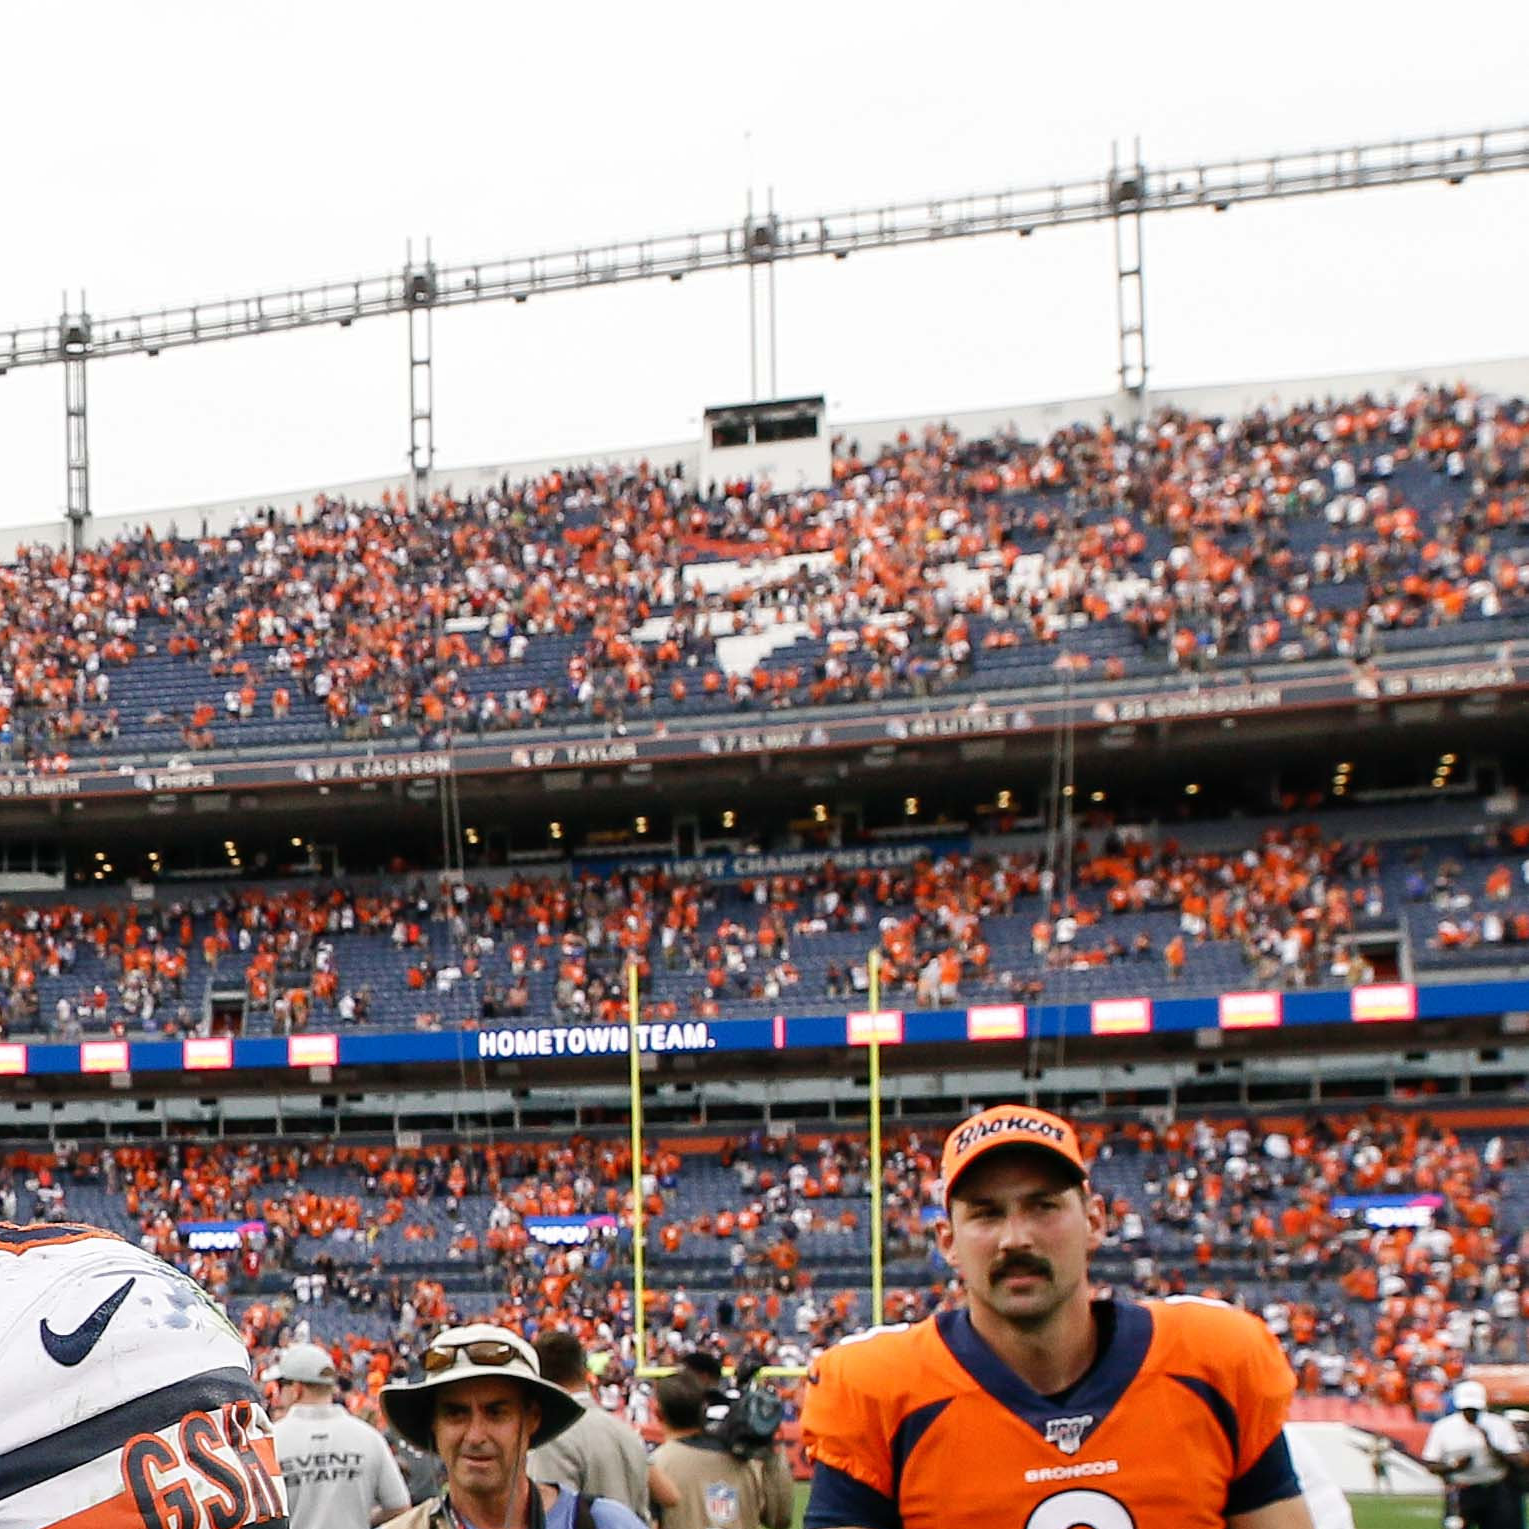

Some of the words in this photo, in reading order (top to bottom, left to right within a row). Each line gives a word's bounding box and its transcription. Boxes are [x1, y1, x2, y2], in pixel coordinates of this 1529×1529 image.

[939, 711, 1007, 735] LITTLE
[741, 728, 803, 752] ELWAY
[566, 743, 637, 765] TAYLOR
[360, 755, 451, 778] JACKSON
[29, 778, 80, 796] SMITH
[478, 1025, 630, 1058] HOMETOWN
[634, 1022, 717, 1051] TEAM.
[955, 1115, 1066, 1156] Broncos
[279, 1453, 364, 1473] EVENT
[1024, 1459, 1119, 1484] BRONCOS
[283, 1468, 363, 1489] STAFF
